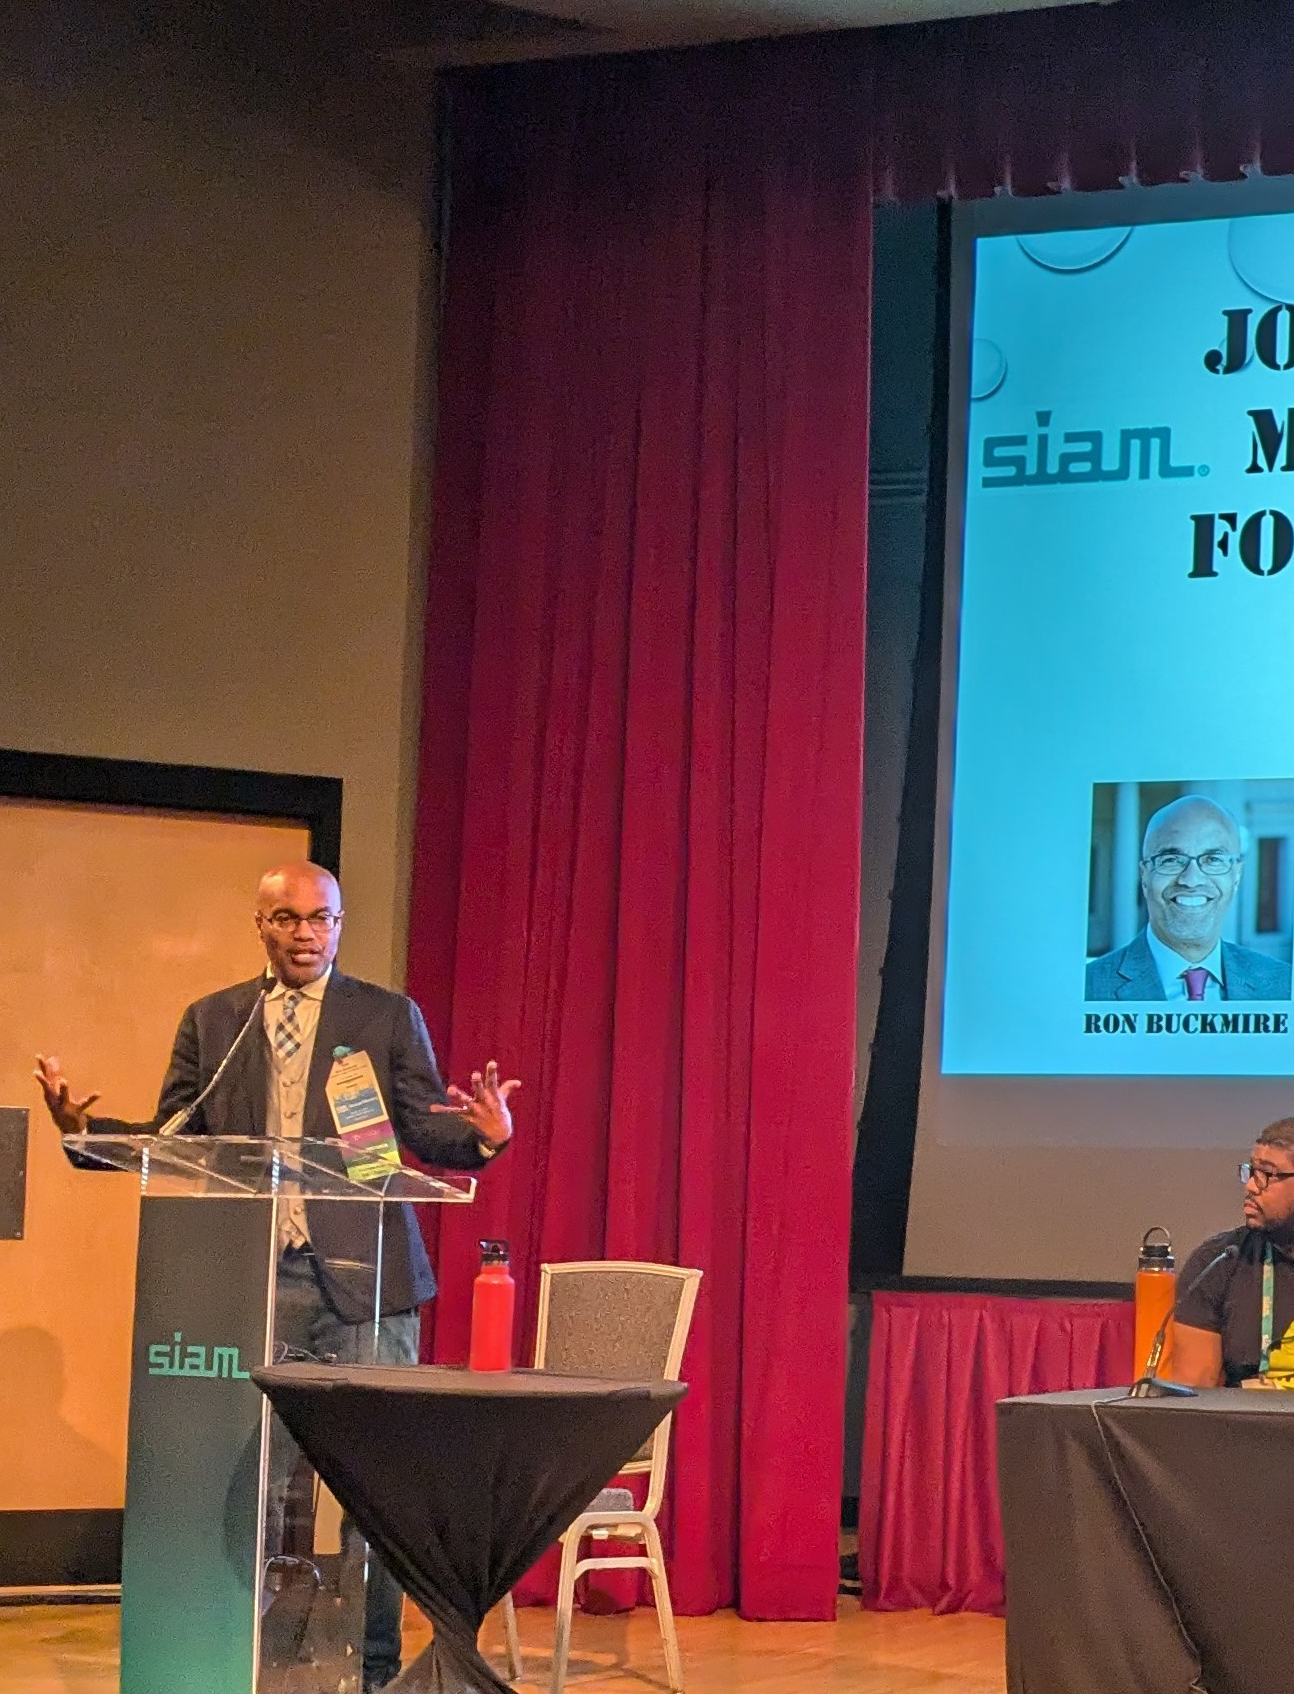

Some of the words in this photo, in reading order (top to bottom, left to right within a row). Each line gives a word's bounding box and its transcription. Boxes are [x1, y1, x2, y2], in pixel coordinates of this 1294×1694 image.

[1084, 1013, 1138, 1034] RON
[1145, 1013, 1288, 1034] BUCKMIRE
[149, 1331, 250, 1379] siam
